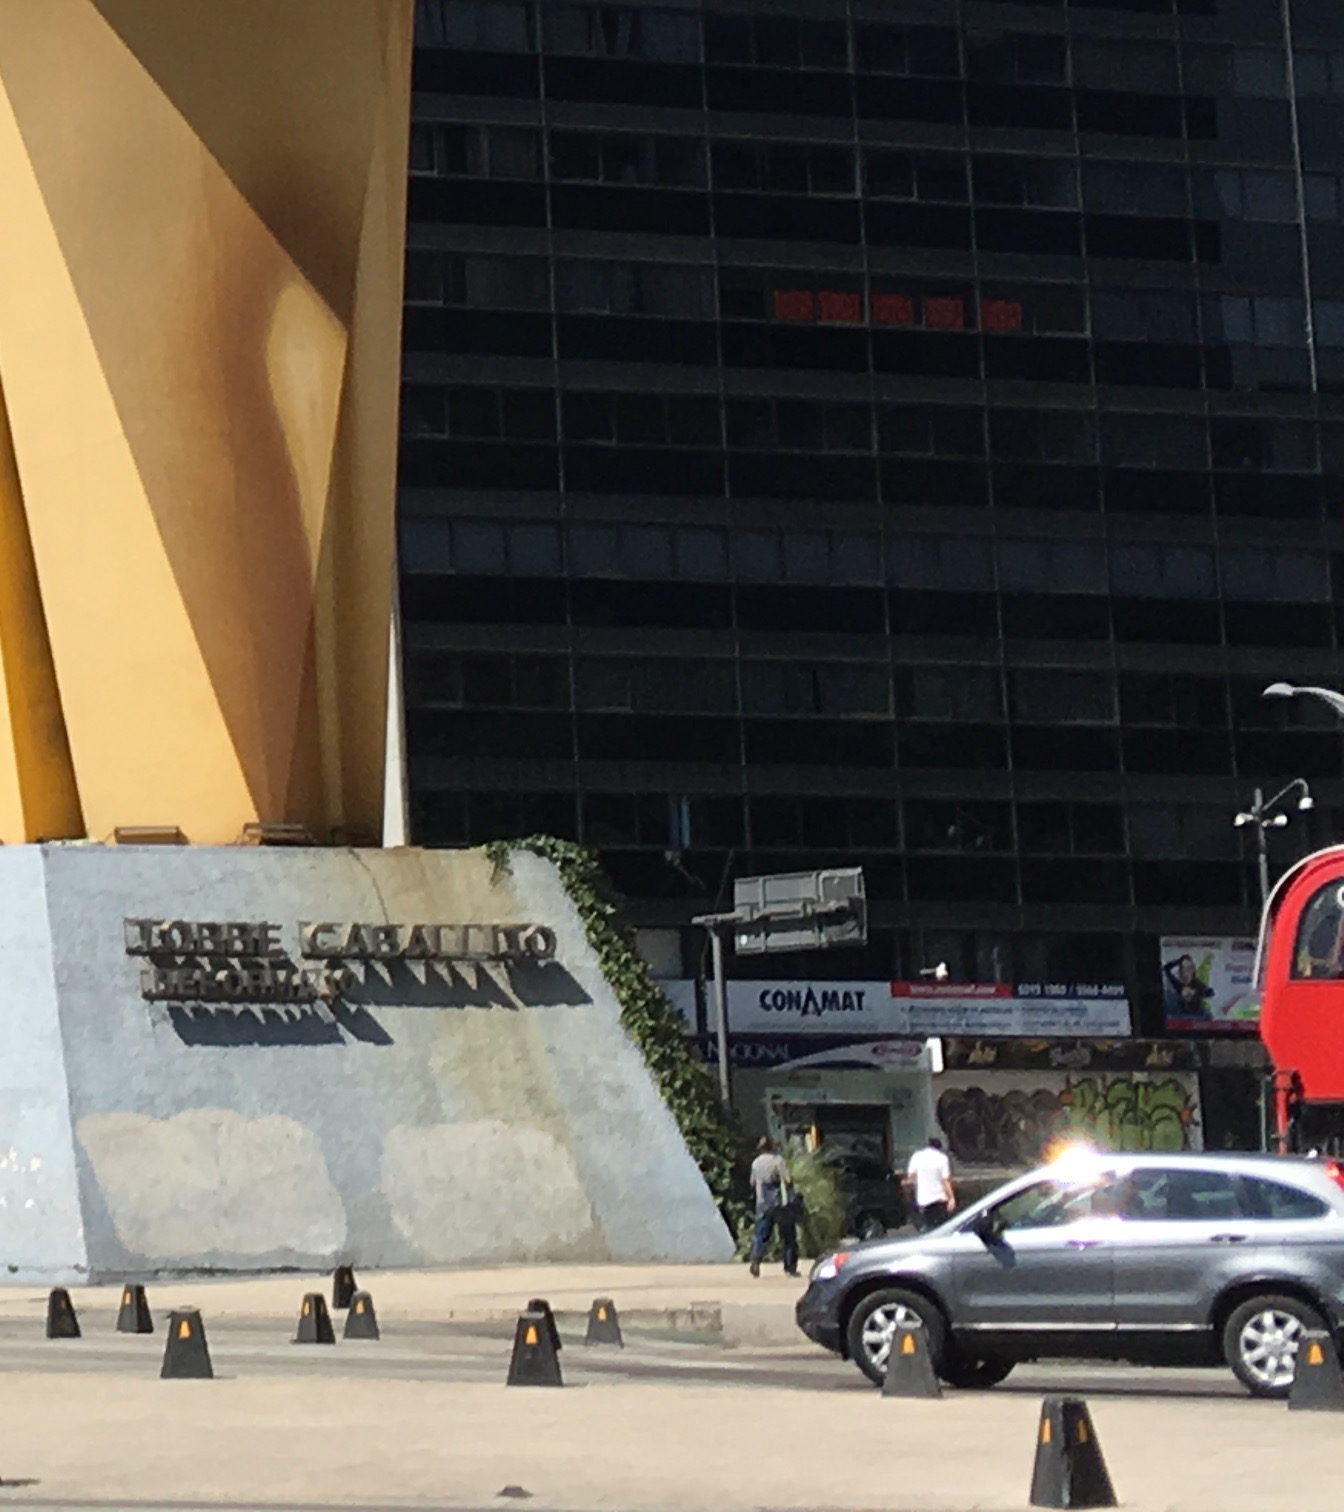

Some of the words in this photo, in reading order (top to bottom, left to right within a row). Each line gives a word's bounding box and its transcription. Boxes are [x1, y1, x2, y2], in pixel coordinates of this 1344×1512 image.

[126, 919, 284, 956] TORRE
[300, 921, 557, 960] CABALLITO
[759, 987, 864, 1016] CONAMAT
